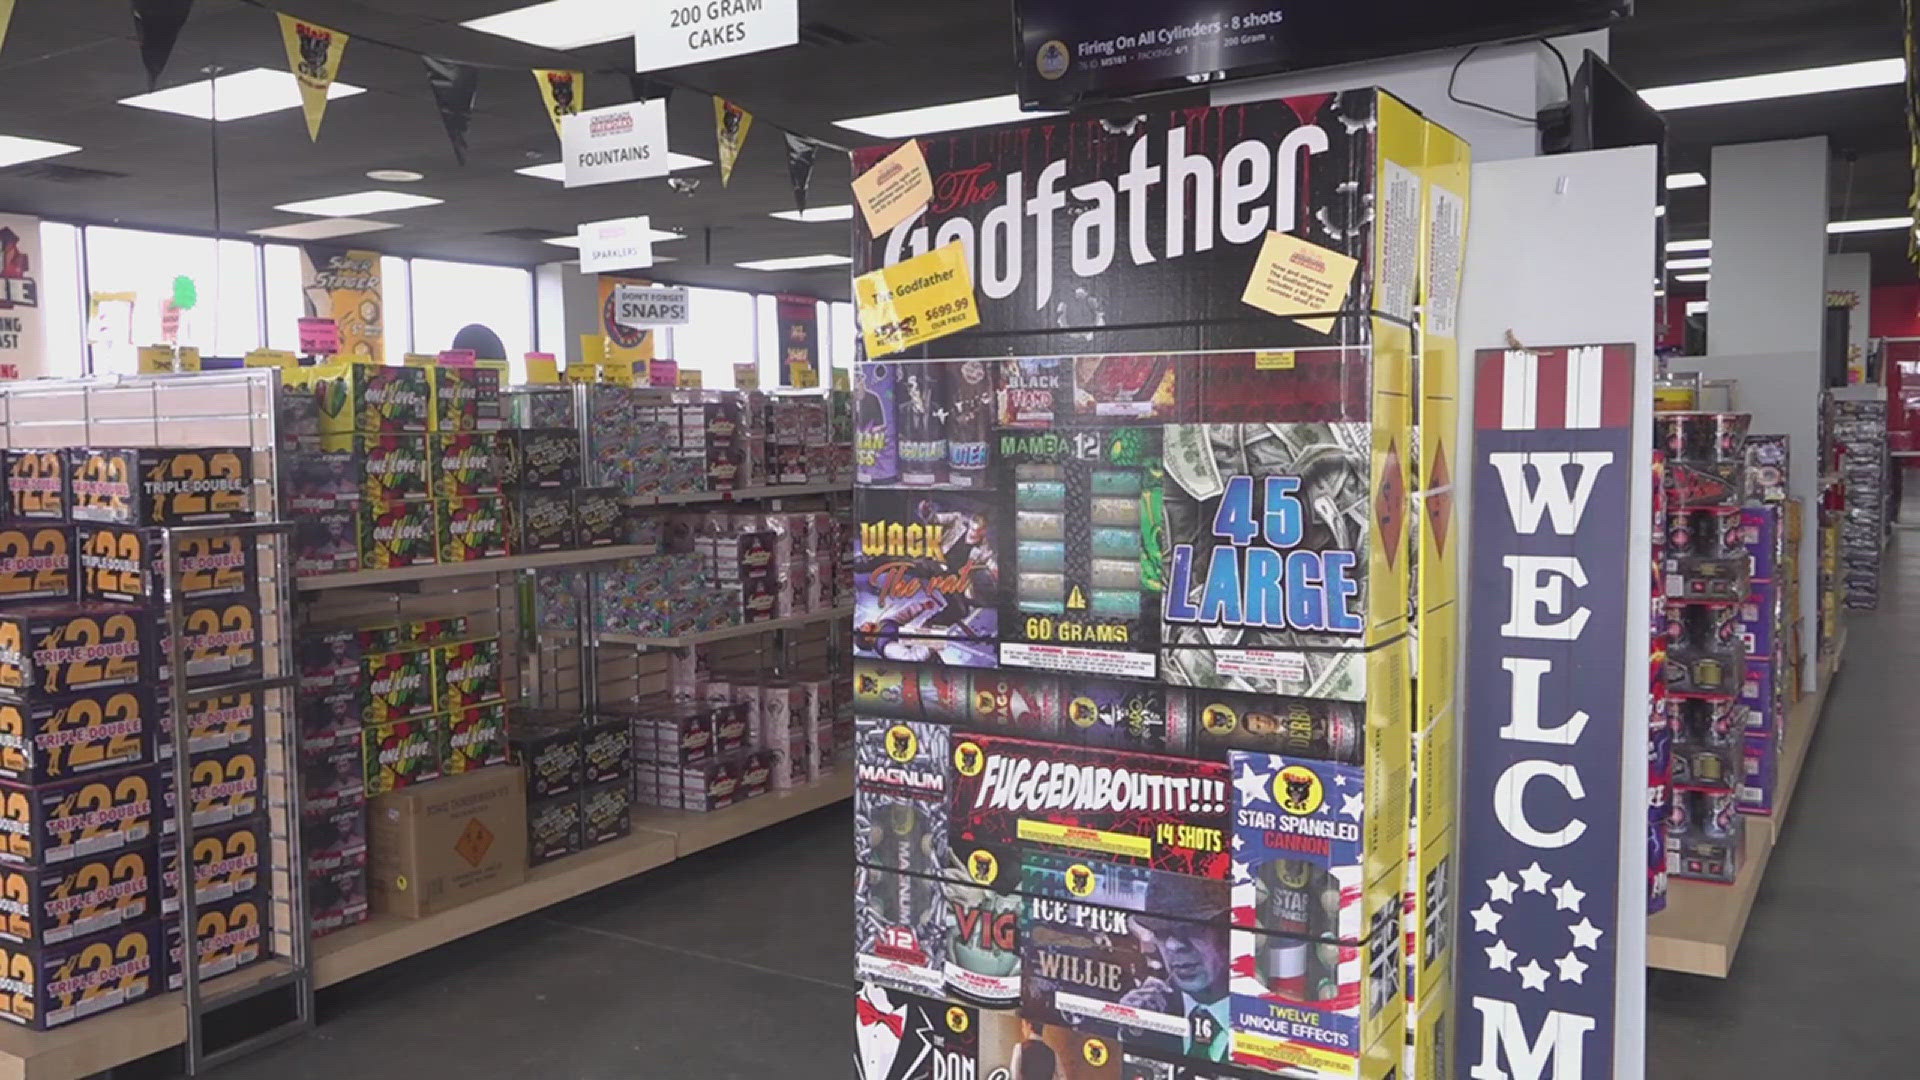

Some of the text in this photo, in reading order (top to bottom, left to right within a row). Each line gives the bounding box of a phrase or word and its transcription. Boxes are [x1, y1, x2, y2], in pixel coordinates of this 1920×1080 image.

[671, 0, 762, 28] 200 GRAM
[688, 22, 746, 50] CAKES
[1078, 39, 1114, 57] Firing
[1117, 36, 1136, 51] On
[1138, 32, 1155, 47] All
[1158, 20, 1221, 45] Cylinders
[1231, 15, 1241, 30] 8
[1243, 9, 1283, 27] shots
[578, 145, 650, 167] FOUNTAINS
[931, 162, 999, 214] The
[592, 247, 638, 260] SPARKLERS
[896, 268, 955, 297] Godfather
[622, 303, 686, 320] SNAPS!
[651, 293, 684, 302] FORGET
[925, 297, 969, 322] $699.99
[1009, 376, 1060, 389] BLACK
[1001, 432, 1101, 460] MAMBA 12
[366, 458, 417, 474] ONE LOVE
[442, 455, 489, 470] ONE LOVE
[22, 454, 61, 511] 22
[144, 479, 243, 494] TRIPLE DOUBLE
[171, 454, 249, 513] 22
[1212, 475, 1304, 549] 45
[373, 524, 423, 540] ONE LOVE
[450, 519, 497, 534] ONE LOVE
[860, 519, 947, 563] WACK
[0, 528, 68, 592] 22
[17, 554, 69, 570] DOUBLE
[96, 530, 143, 594] 22
[197, 551, 244, 568] DOUBLE
[868, 561, 922, 609] The
[1165, 543, 1363, 633] LARGE
[187, 605, 254, 660] 22
[206, 628, 255, 645] DOUBLE
[1026, 617, 1129, 644] 60 GRAMS
[34, 640, 140, 667] TRIPLE DOUBLE
[65, 614, 140, 686] 22
[371, 673, 422, 696] ONE LOVE
[446, 663, 492, 683] ONE LOVE
[67, 692, 142, 766] 22
[206, 706, 254, 725] DOUBLE
[35, 718, 142, 749] TRIPLE DOUBLE
[379, 741, 430, 765] ONE LOVE
[192, 754, 257, 813] 22
[211, 777, 258, 797] DOUBLE
[859, 764, 945, 792] MAGNUM
[974, 754, 1226, 813] FUGGEDABOUTIT!!!
[46, 800, 151, 836] TRIPLE DOUBLE
[77, 776, 151, 838] 22
[1284, 799, 1308, 811] Cat
[1156, 822, 1176, 846] 14
[1177, 825, 1223, 853] SHOTS
[1237, 809, 1359, 841] STAR SPANGLED
[1264, 830, 1330, 857] CANNON
[193, 829, 258, 888] 22
[211, 852, 258, 874] DOUBLE
[45, 875, 148, 918] TRIPLE DOUBLE
[75, 853, 147, 916] 22
[953, 901, 1017, 951] VIG
[1032, 897, 1129, 936] ICE PICK
[886, 929, 914, 950] 12
[47, 954, 151, 999] TRIPLE DOUBLE
[78, 931, 151, 998] 22
[1038, 949, 1123, 993] WILLIE
[1194, 1017, 1212, 1038] 16
[1268, 1003, 1321, 1026] TWELVE
[1239, 1013, 1350, 1048] UNIQUE EFFECTS
[933, 1047, 976, 1080] DON
